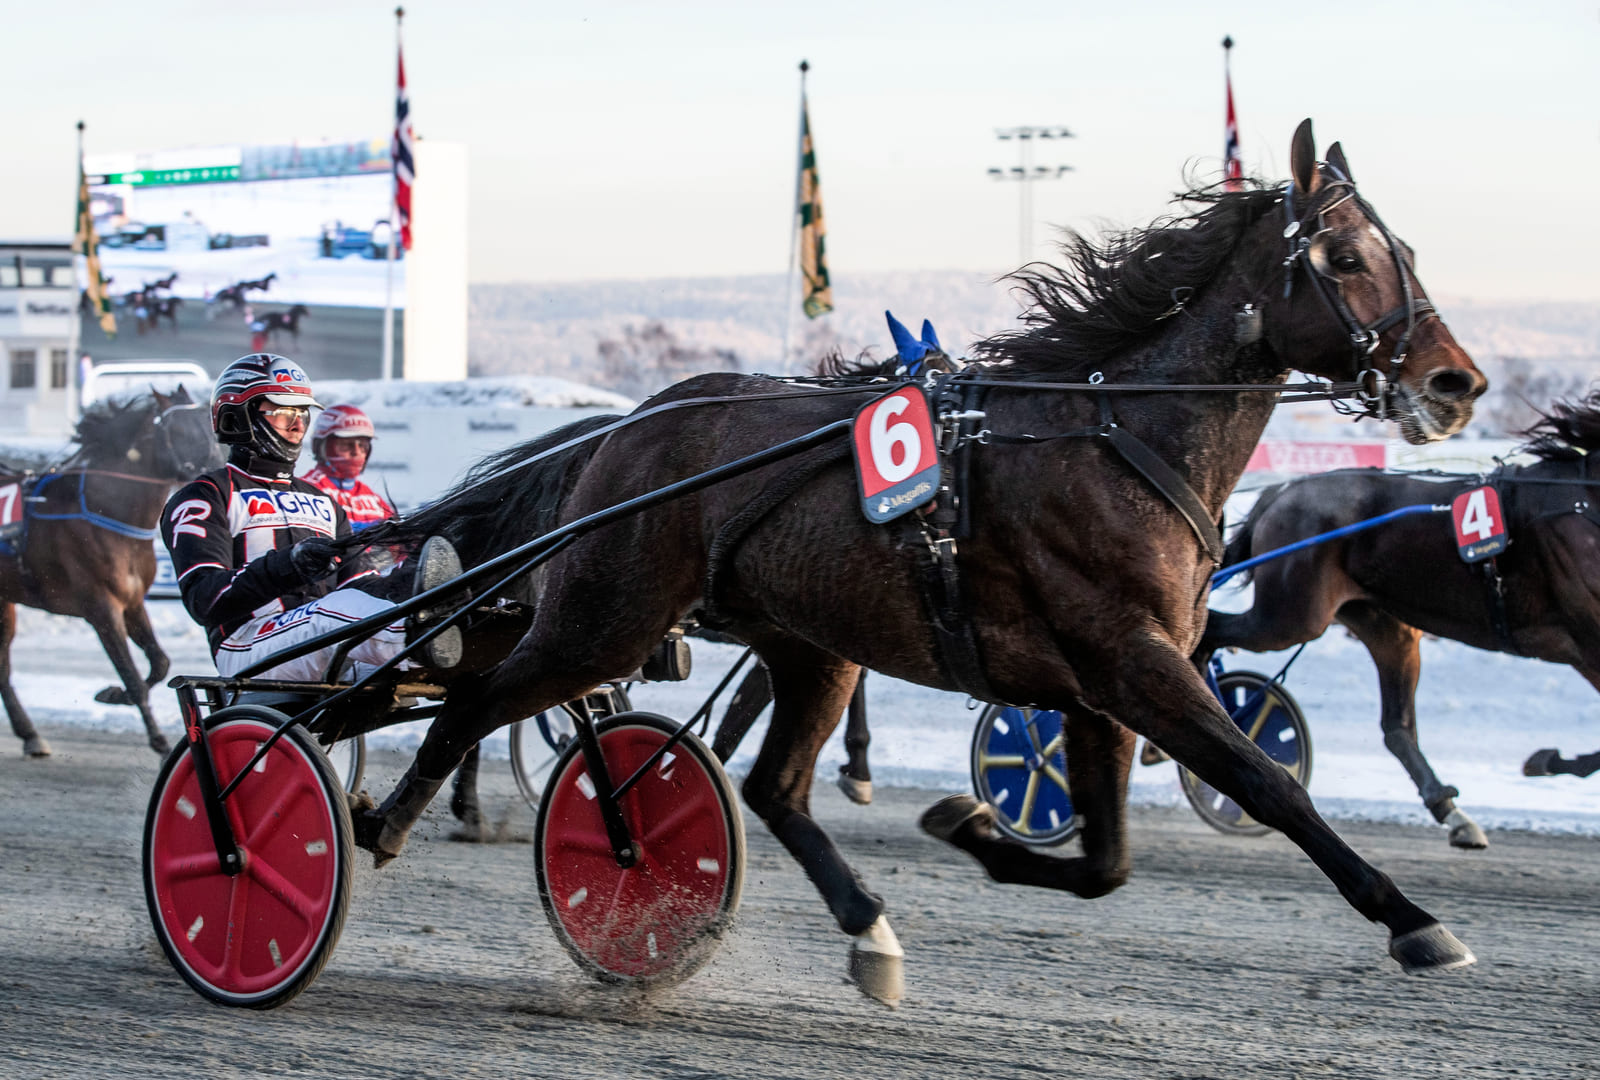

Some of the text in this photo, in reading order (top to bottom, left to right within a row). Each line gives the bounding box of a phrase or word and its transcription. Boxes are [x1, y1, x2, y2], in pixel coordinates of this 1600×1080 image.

[870, 395, 921, 482] 6
[0, 483, 19, 526] 7
[276, 491, 331, 522] GHG
[1461, 489, 1494, 540] 4
